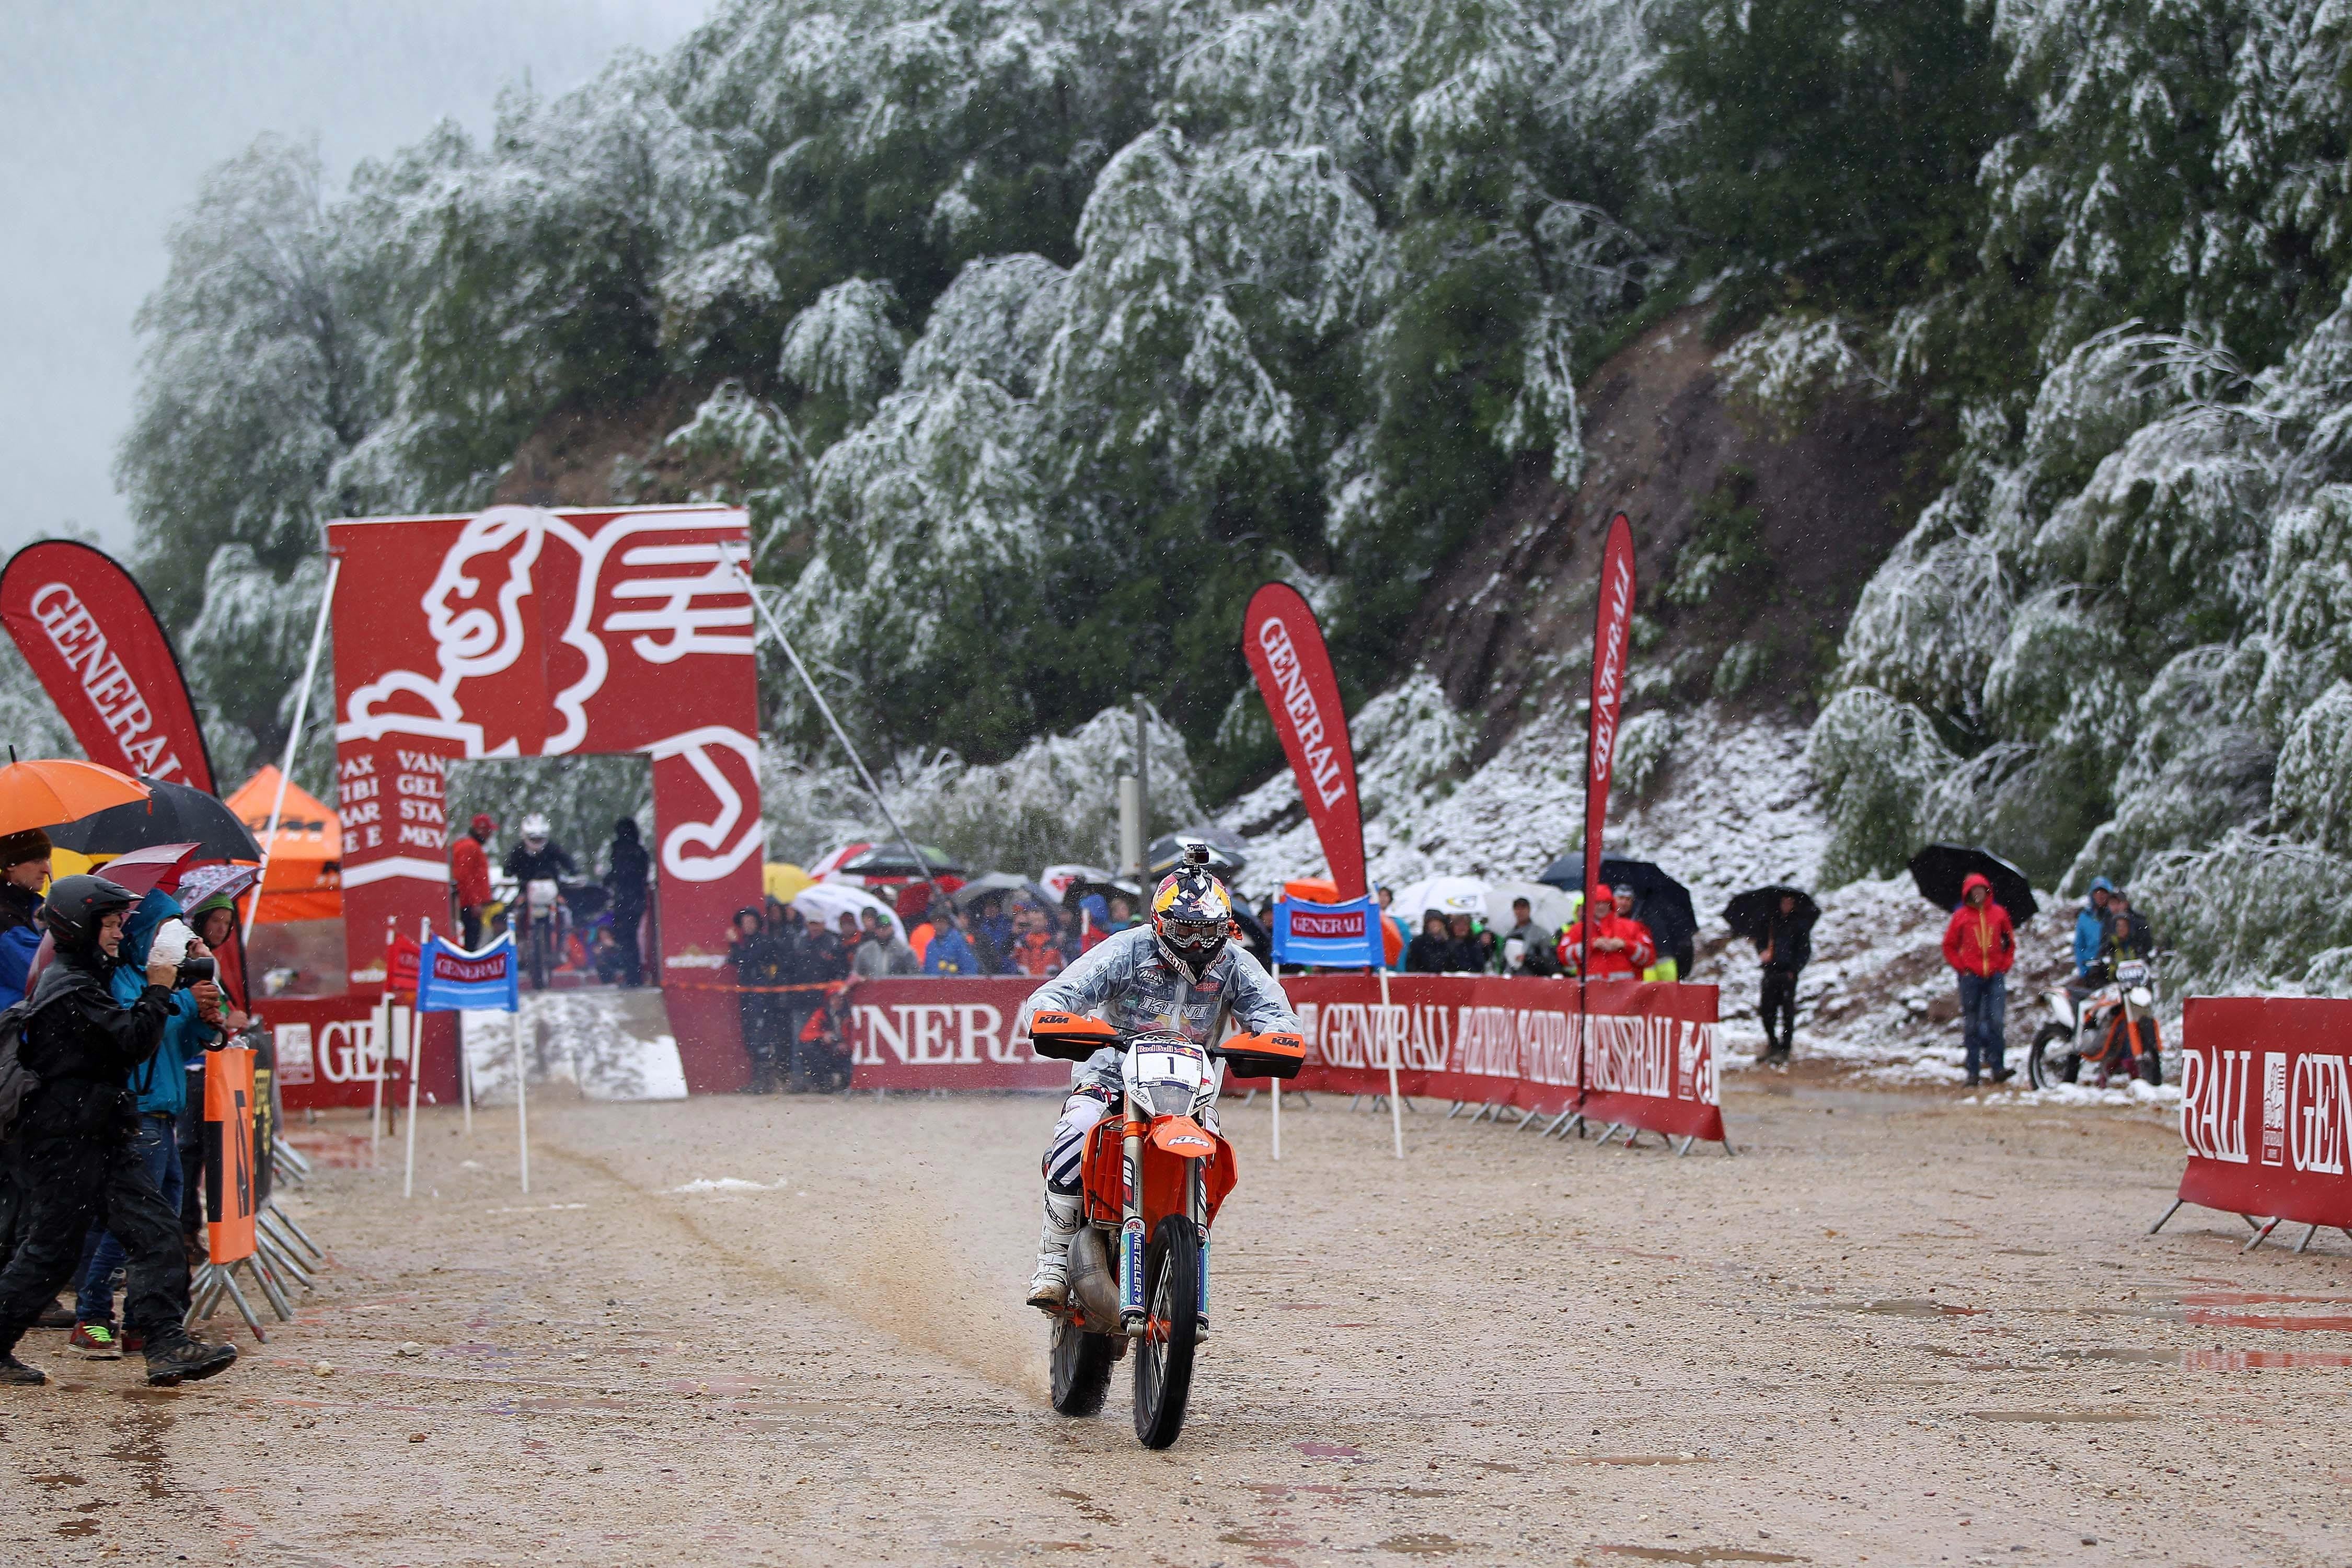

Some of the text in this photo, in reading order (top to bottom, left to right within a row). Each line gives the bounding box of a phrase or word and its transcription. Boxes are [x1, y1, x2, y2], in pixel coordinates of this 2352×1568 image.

[1259, 616, 1347, 811] GENERALI
[397, 774, 444, 800] GEL
[399, 798, 444, 825] STA
[1292, 917, 1364, 934] GENERALI
[435, 957, 505, 979] GENERALI
[1139, 970, 1164, 984] Airoh
[1037, 1015, 1069, 1024] KTM
[1271, 1036, 1300, 1048] KTM
[1167, 1056, 1175, 1075] 1
[1131, 1089, 1149, 1104] KTM
[2179, 1045, 2252, 1164] RALI
[1167, 1135, 1210, 1148] KTM
[1133, 1232, 1142, 1293] METZELER
[1120, 1254, 1128, 1306] MOTOREX
